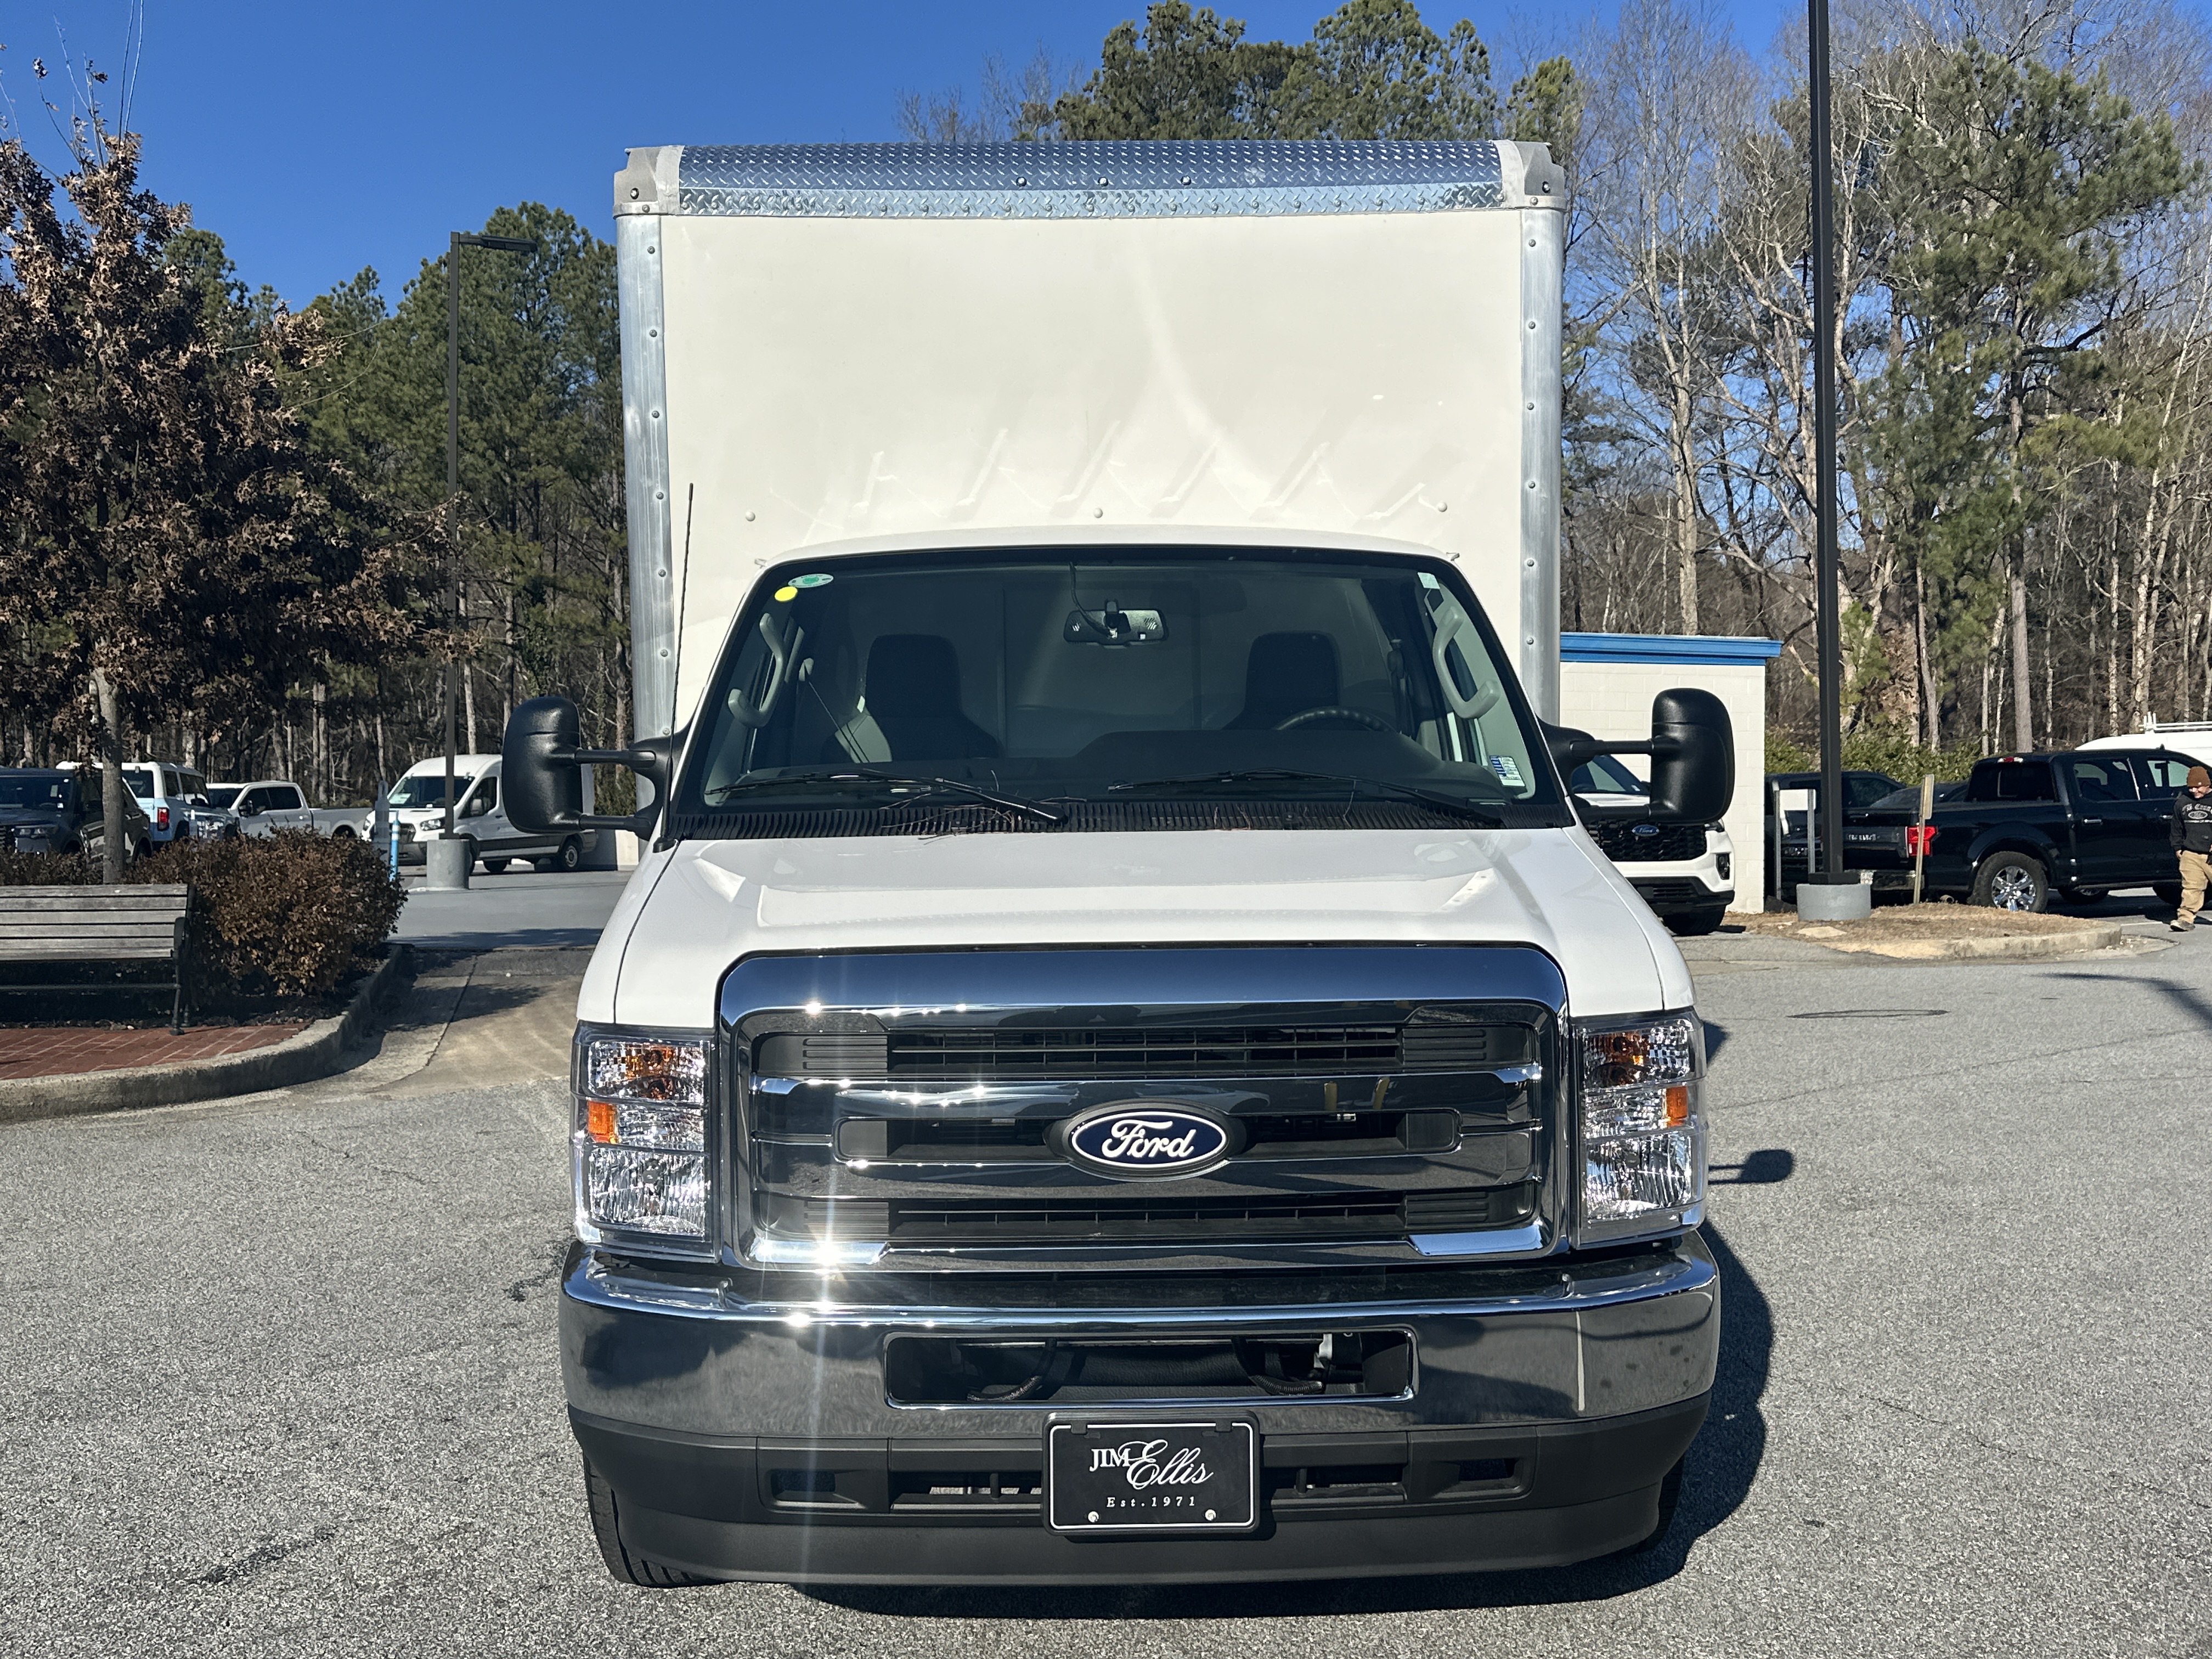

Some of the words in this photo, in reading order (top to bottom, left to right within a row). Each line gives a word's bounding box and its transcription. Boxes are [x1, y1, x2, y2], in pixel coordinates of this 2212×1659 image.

[1102, 1119, 1197, 1158] Ford
[1089, 1448, 1132, 1472] JIM
[1118, 1439, 1214, 1490] Ellis
